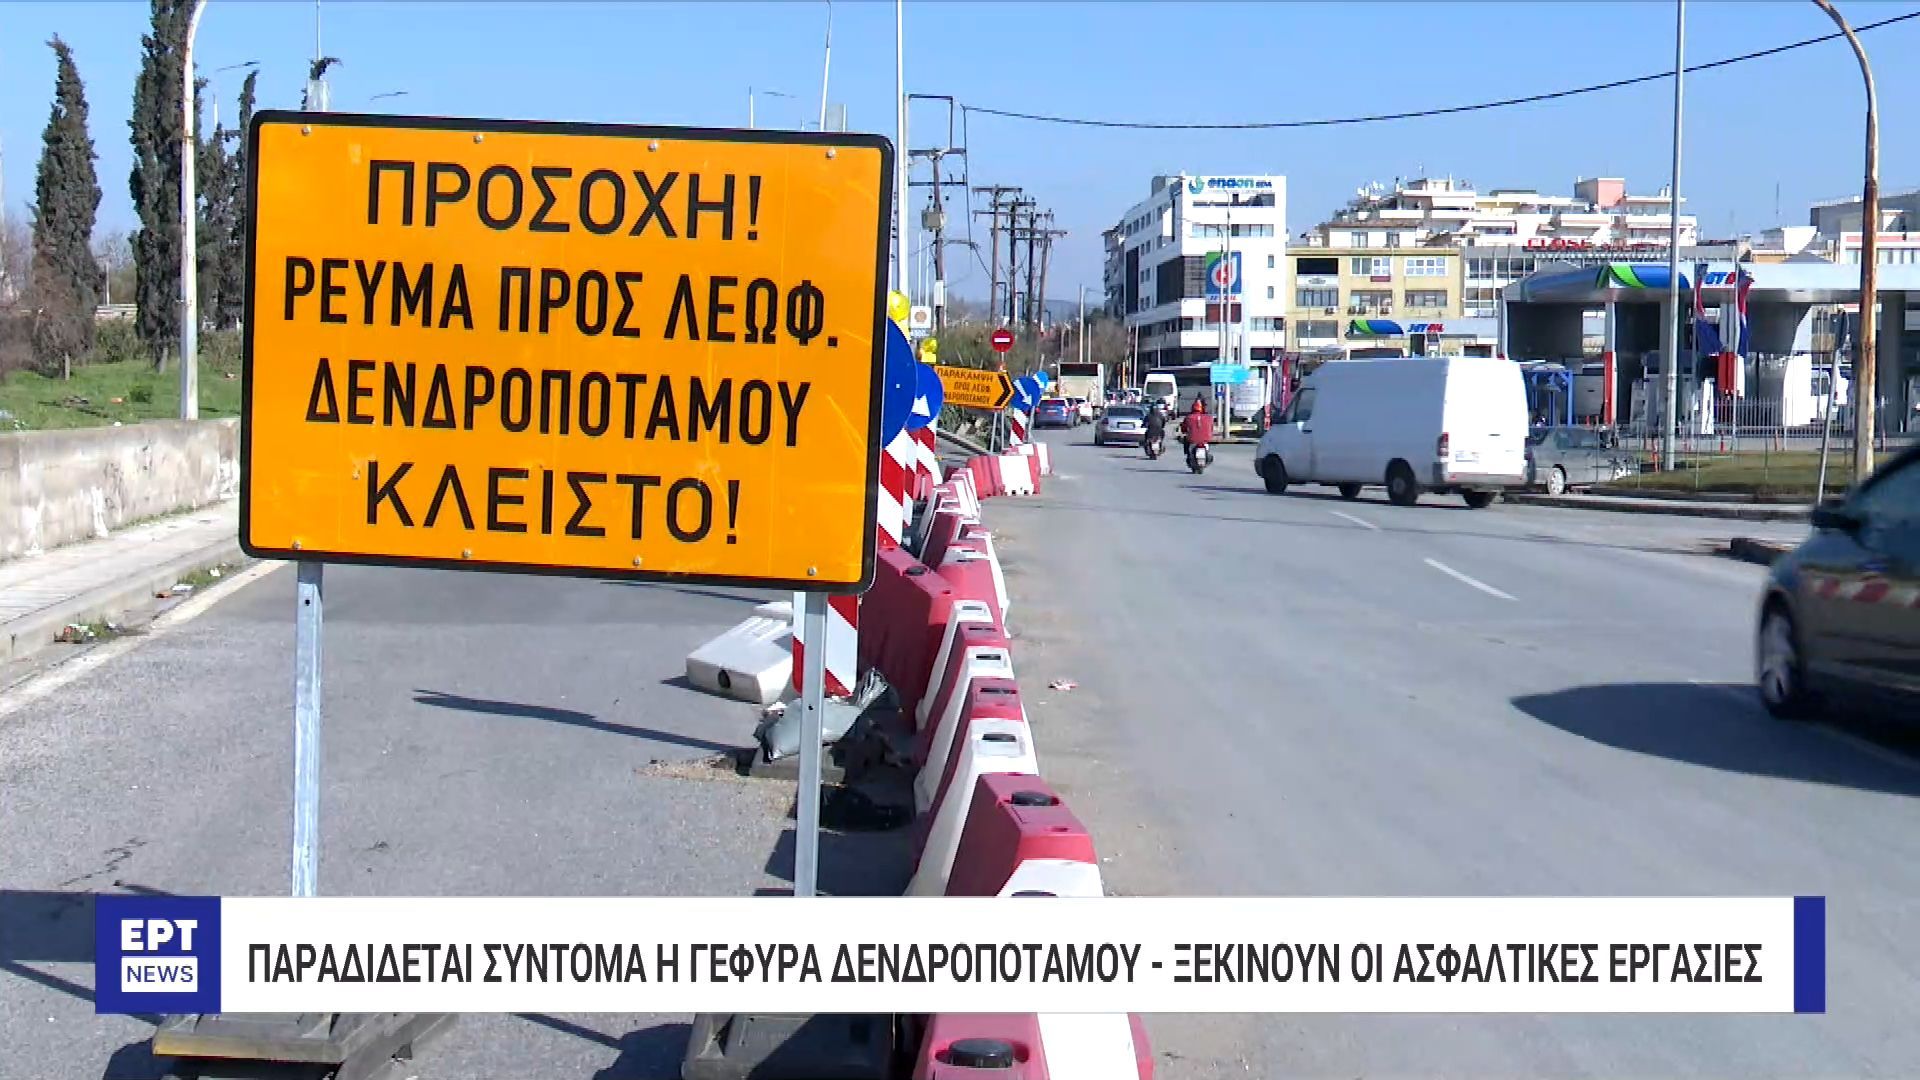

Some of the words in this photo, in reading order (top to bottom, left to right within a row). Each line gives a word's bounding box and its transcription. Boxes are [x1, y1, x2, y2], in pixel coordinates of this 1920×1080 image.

[367, 159, 761, 241] ΠΡΟΣΟΧΗ!
[284, 255, 474, 330] ΡΕΥΜΑ
[499, 265, 643, 338] ΠΡΟΣ
[663, 273, 838, 348] ΛΕΩΦ.
[305, 357, 811, 447] ΔΕΝΔΡΟΠΟΤΑΜΟΥ
[937, 367, 993, 382] ΠΑΡΑΚΑΜΨΗ
[366, 461, 740, 545] ΚΛΕΙΣΤΟ!
